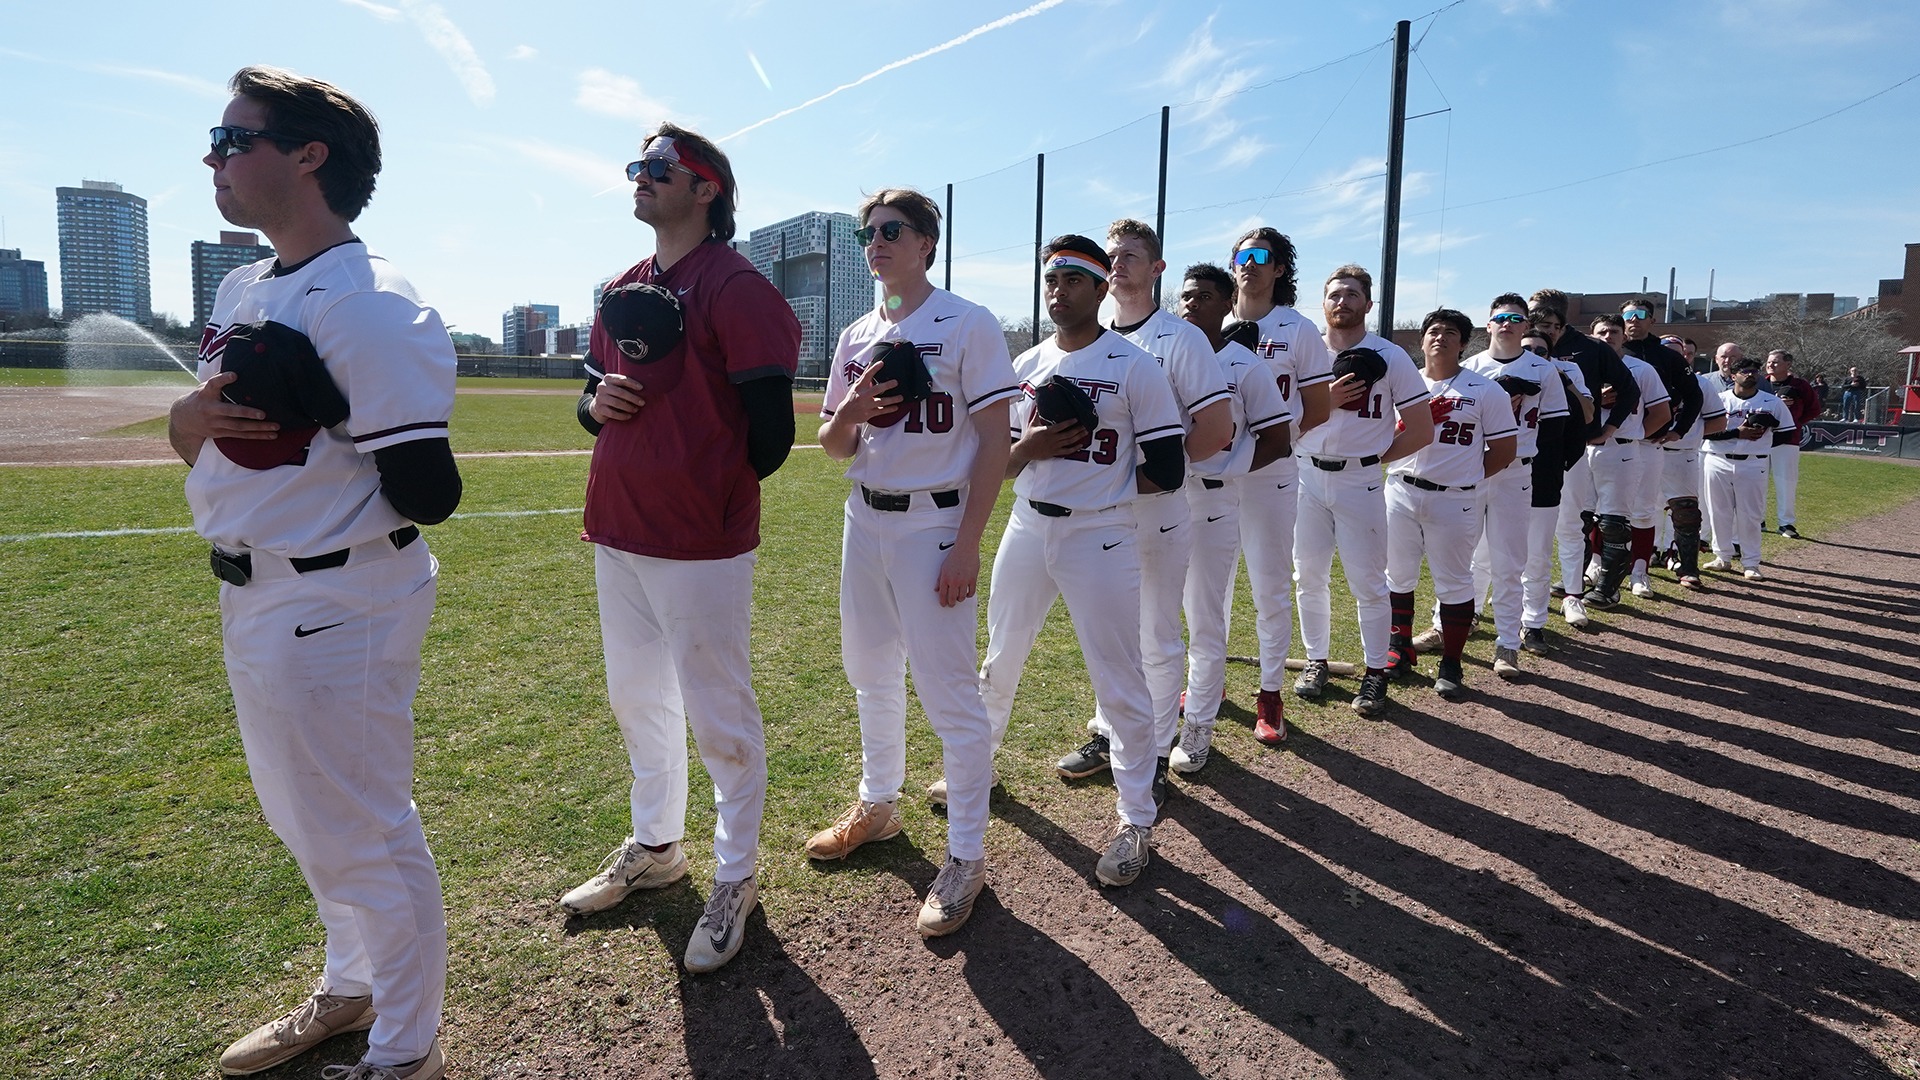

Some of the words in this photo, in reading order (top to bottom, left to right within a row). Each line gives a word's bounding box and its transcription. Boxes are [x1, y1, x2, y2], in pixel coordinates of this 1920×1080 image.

[903, 391, 954, 434] 10
[1438, 421, 1476, 446] 25
[1811, 427, 1900, 446] MIT
